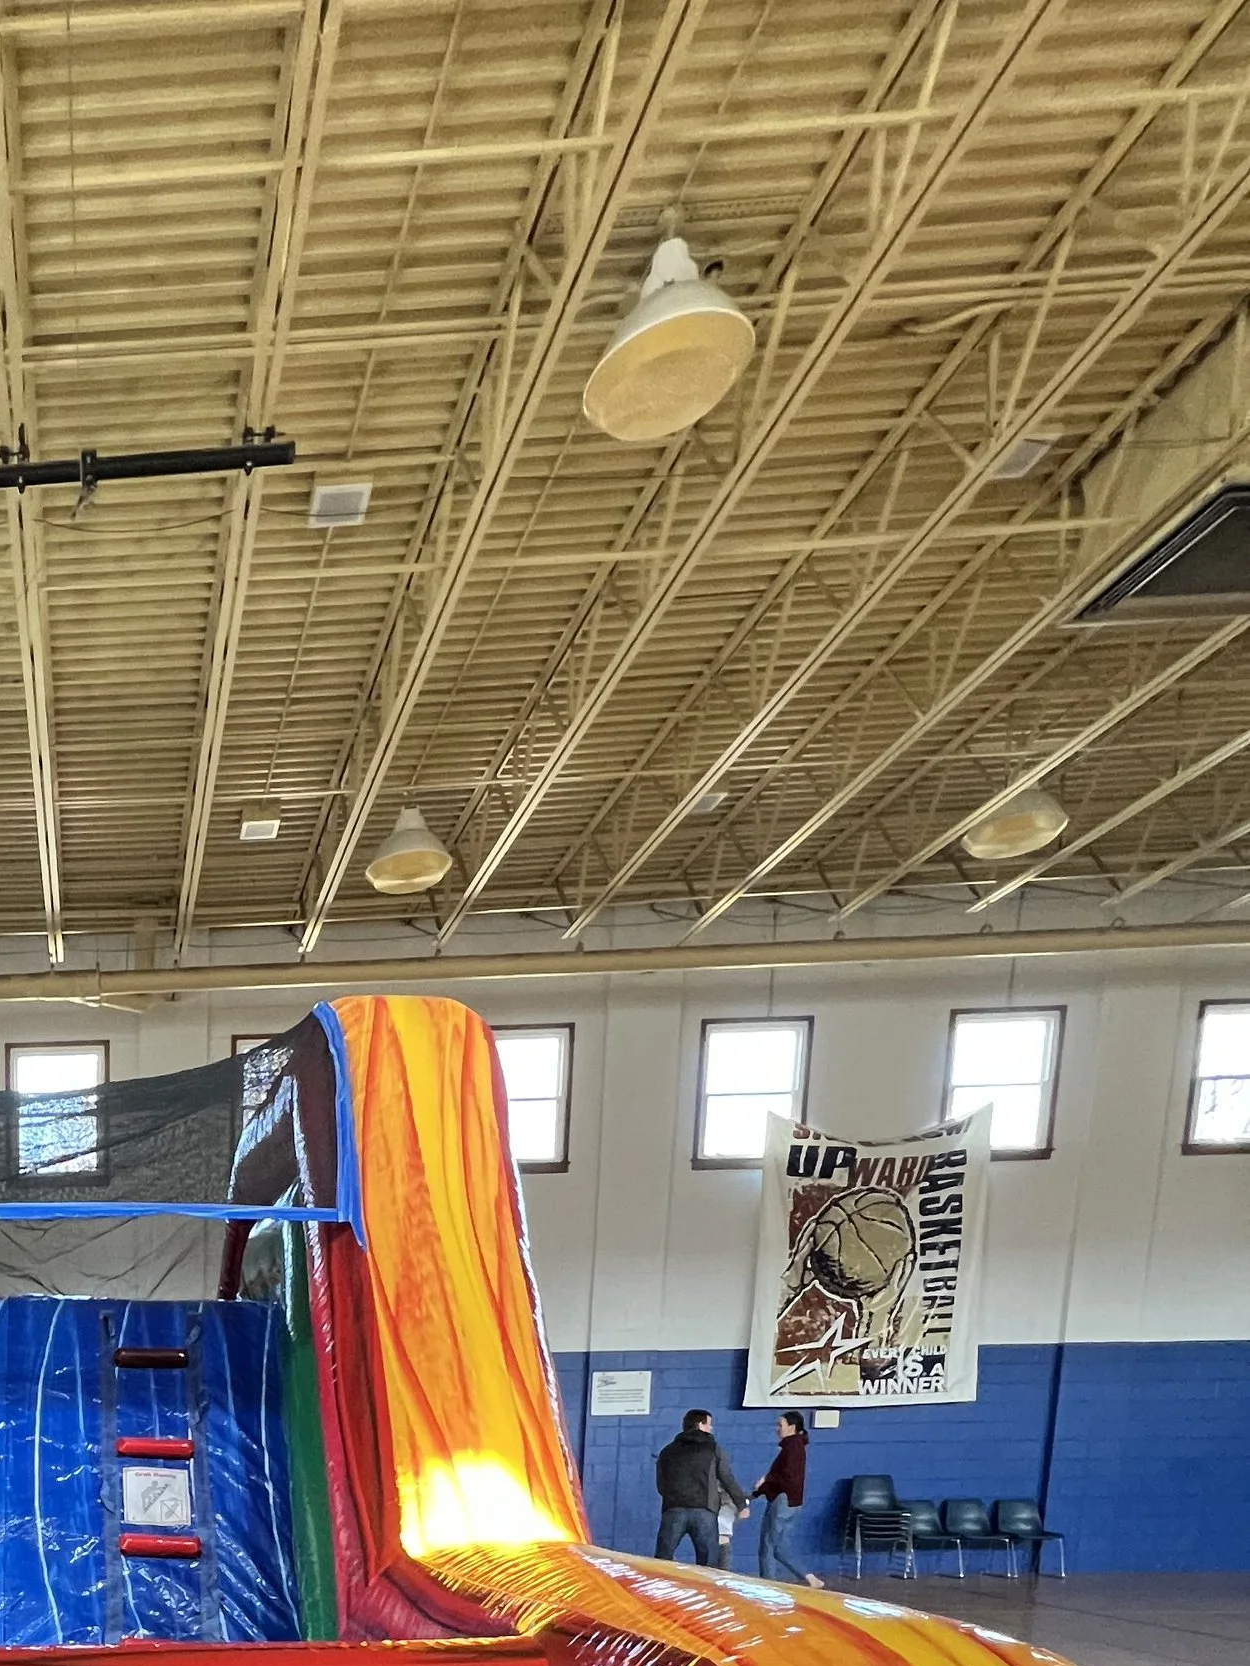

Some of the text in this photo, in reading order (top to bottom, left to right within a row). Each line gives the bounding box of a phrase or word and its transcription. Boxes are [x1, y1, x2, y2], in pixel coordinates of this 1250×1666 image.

[787, 1145, 936, 1188] UPWARD
[919, 1149, 967, 1338] BASKETBALL
[912, 1344, 947, 1357] CHILD
[930, 1363, 945, 1377] A
[857, 1376, 947, 1395] WINNER
